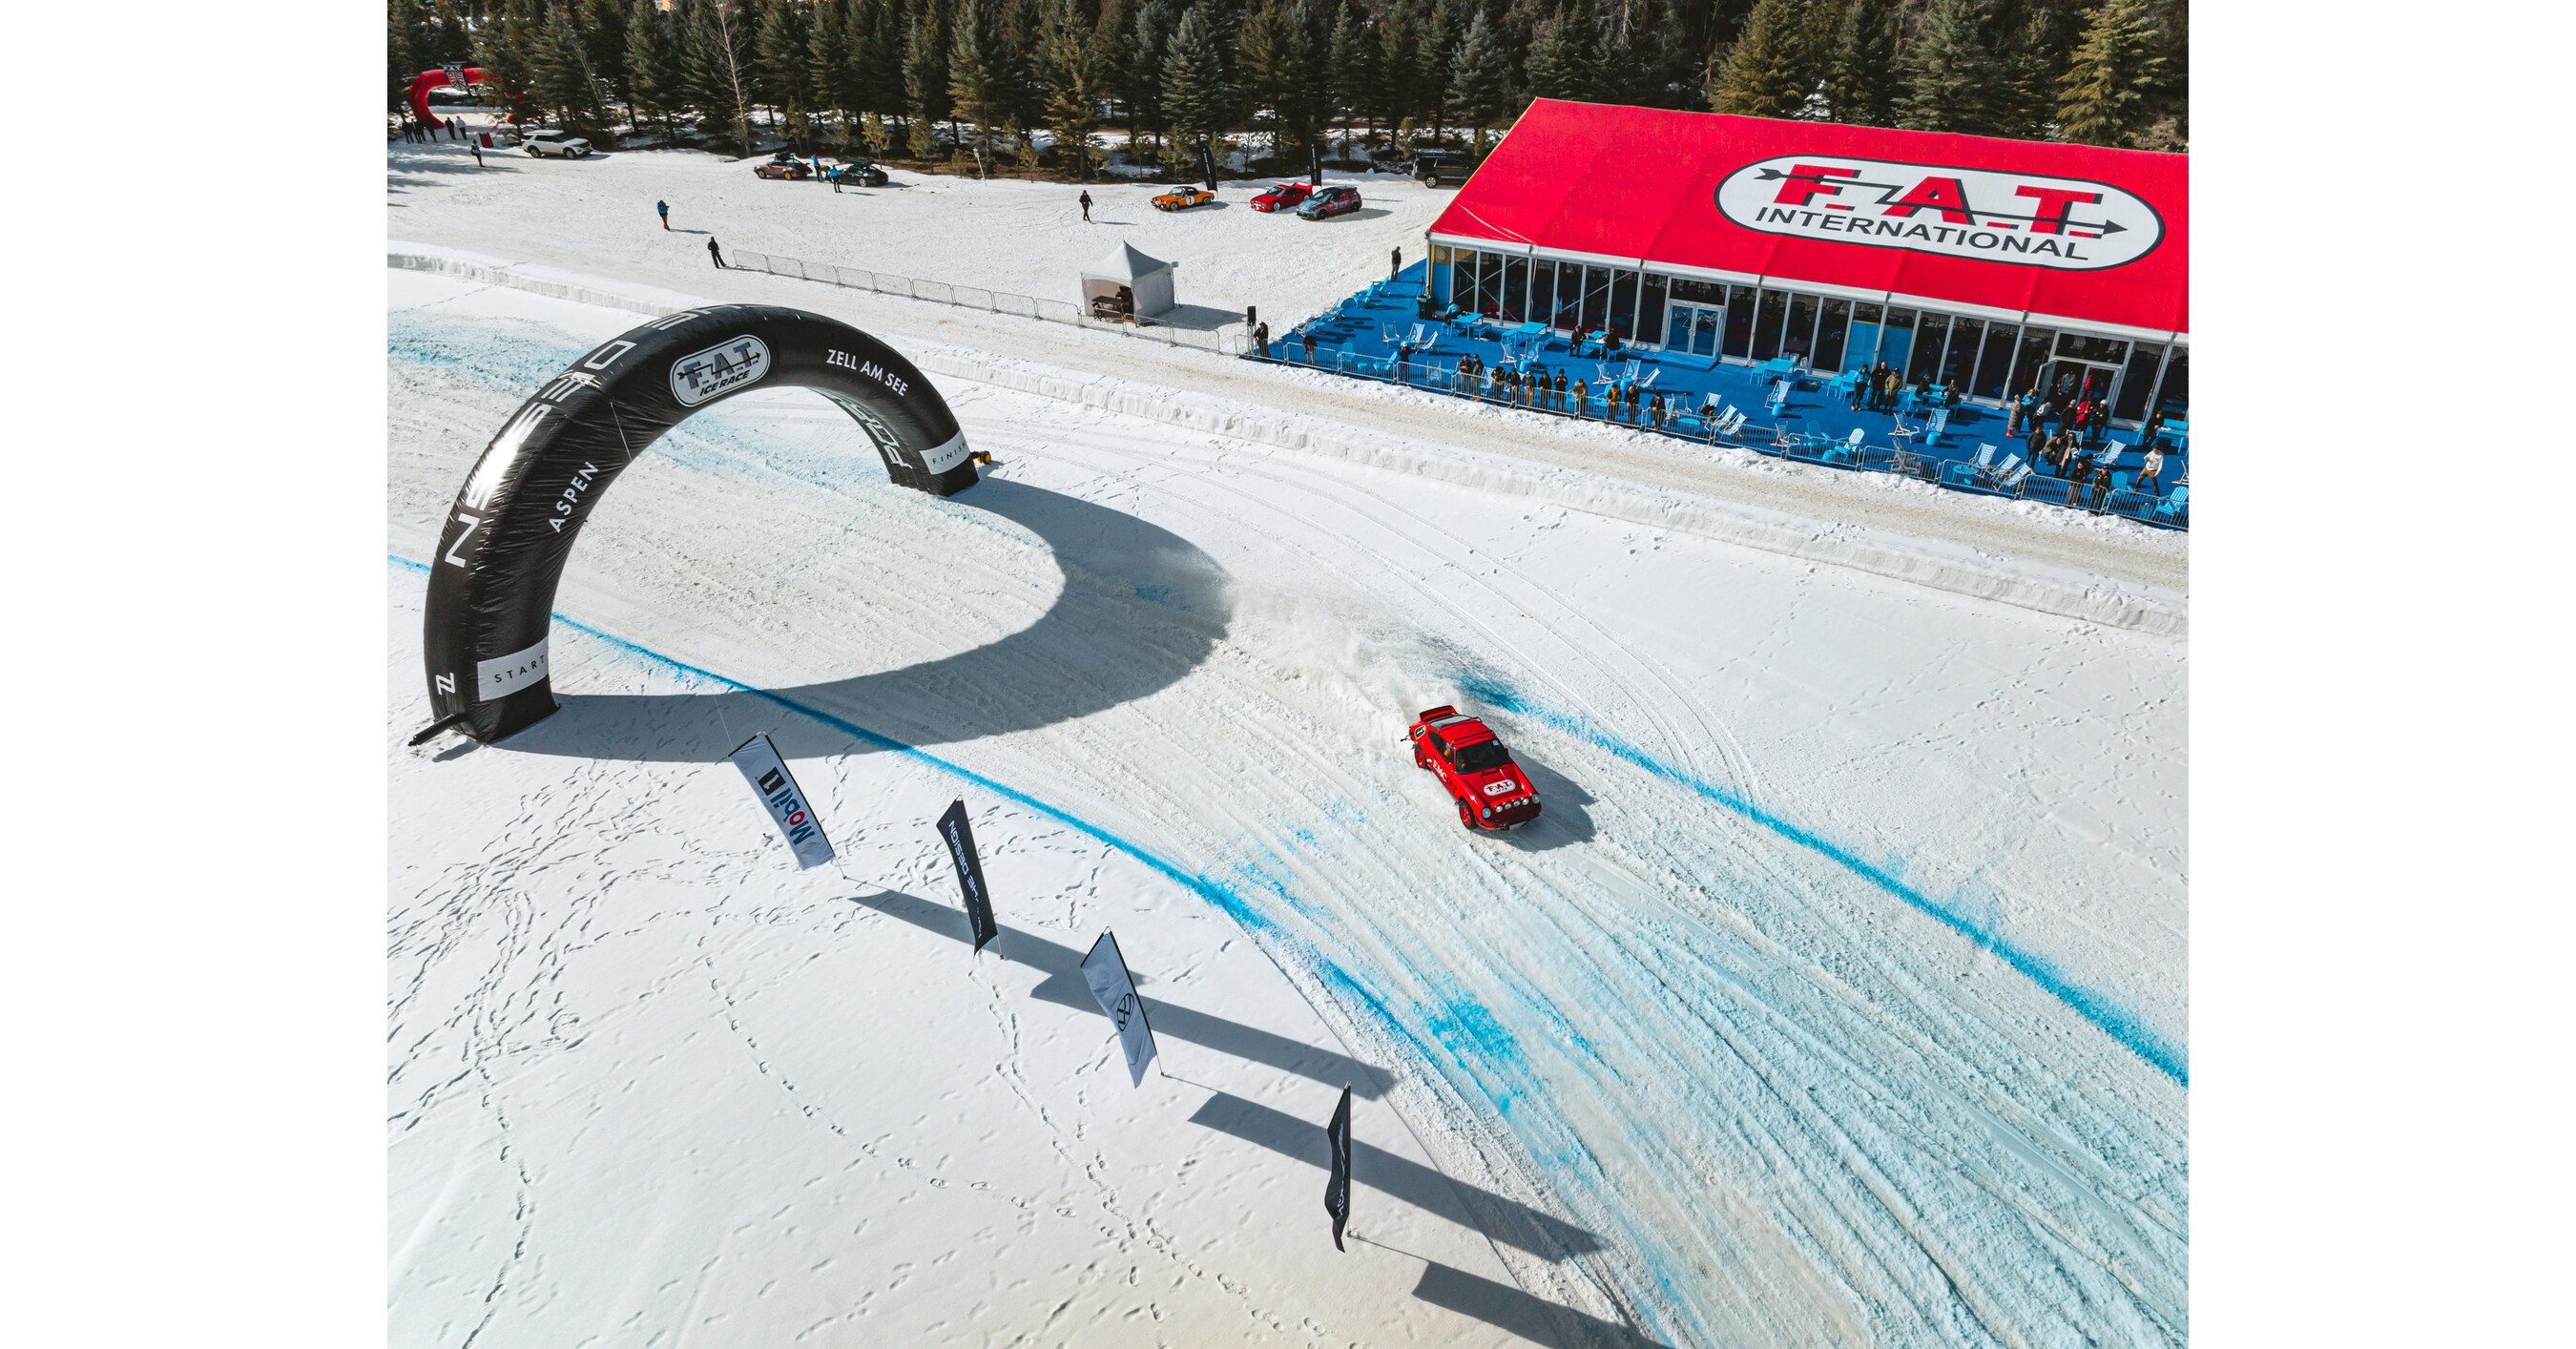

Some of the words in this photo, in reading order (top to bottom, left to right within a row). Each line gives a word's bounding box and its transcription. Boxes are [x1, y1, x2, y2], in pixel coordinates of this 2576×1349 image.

[1755, 206, 2089, 261] INTERNATIONAL
[699, 382, 718, 397] ICE
[719, 369, 751, 389] RACE
[826, 348, 857, 371] ZELL
[860, 360, 883, 382] AM
[884, 372, 908, 397] SEE
[932, 442, 966, 465] FINISH
[549, 461, 599, 533] ASPEN
[494, 654, 545, 683] START
[769, 787, 816, 846] Mobil
[948, 820, 969, 876] DESIGN
